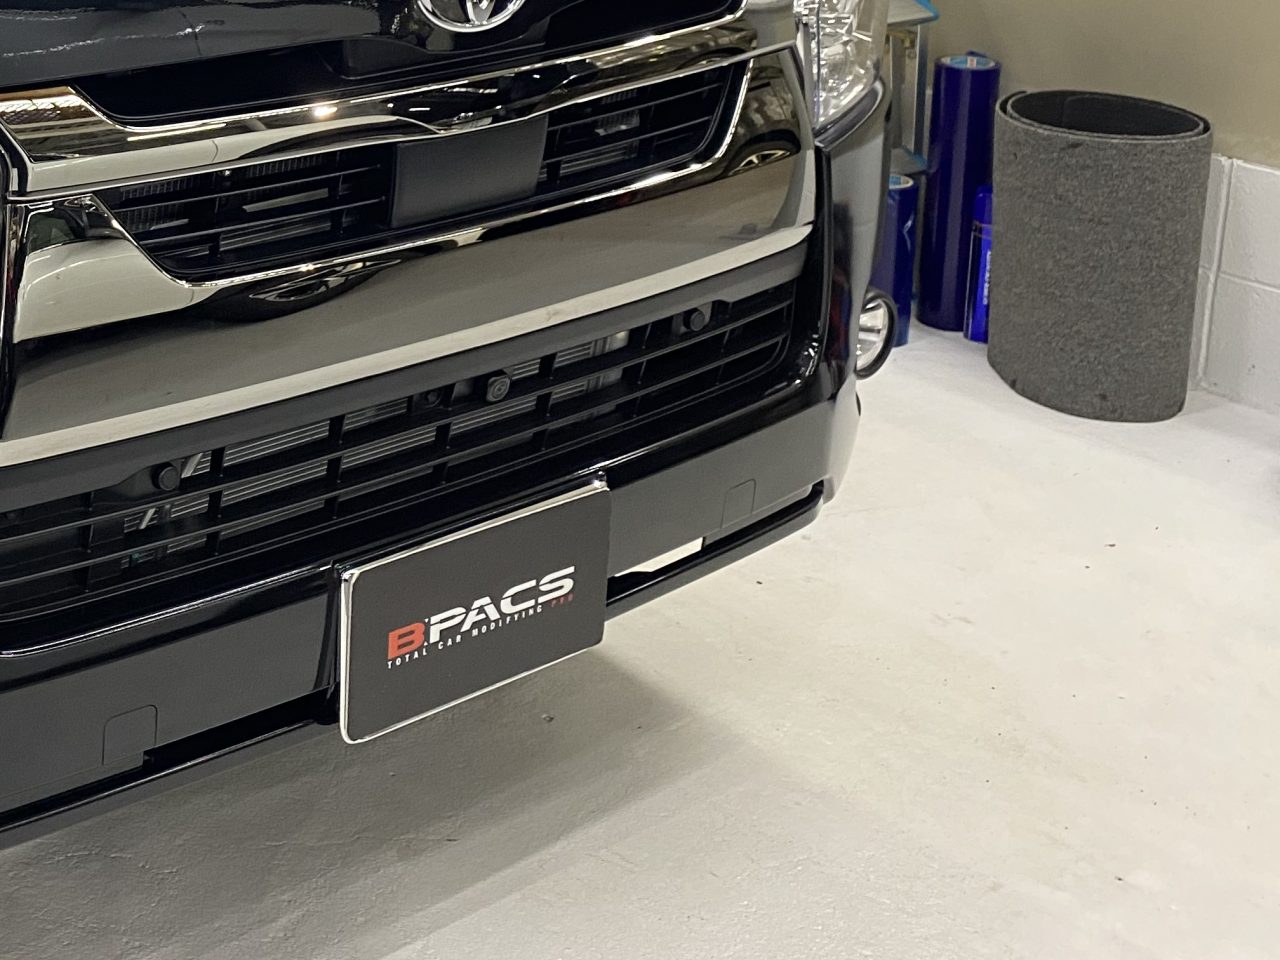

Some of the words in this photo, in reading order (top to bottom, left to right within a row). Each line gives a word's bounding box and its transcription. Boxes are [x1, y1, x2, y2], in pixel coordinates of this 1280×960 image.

[387, 648, 428, 670] TOTAL
[438, 635, 461, 650] CAR
[472, 604, 543, 637] MODIFYING
